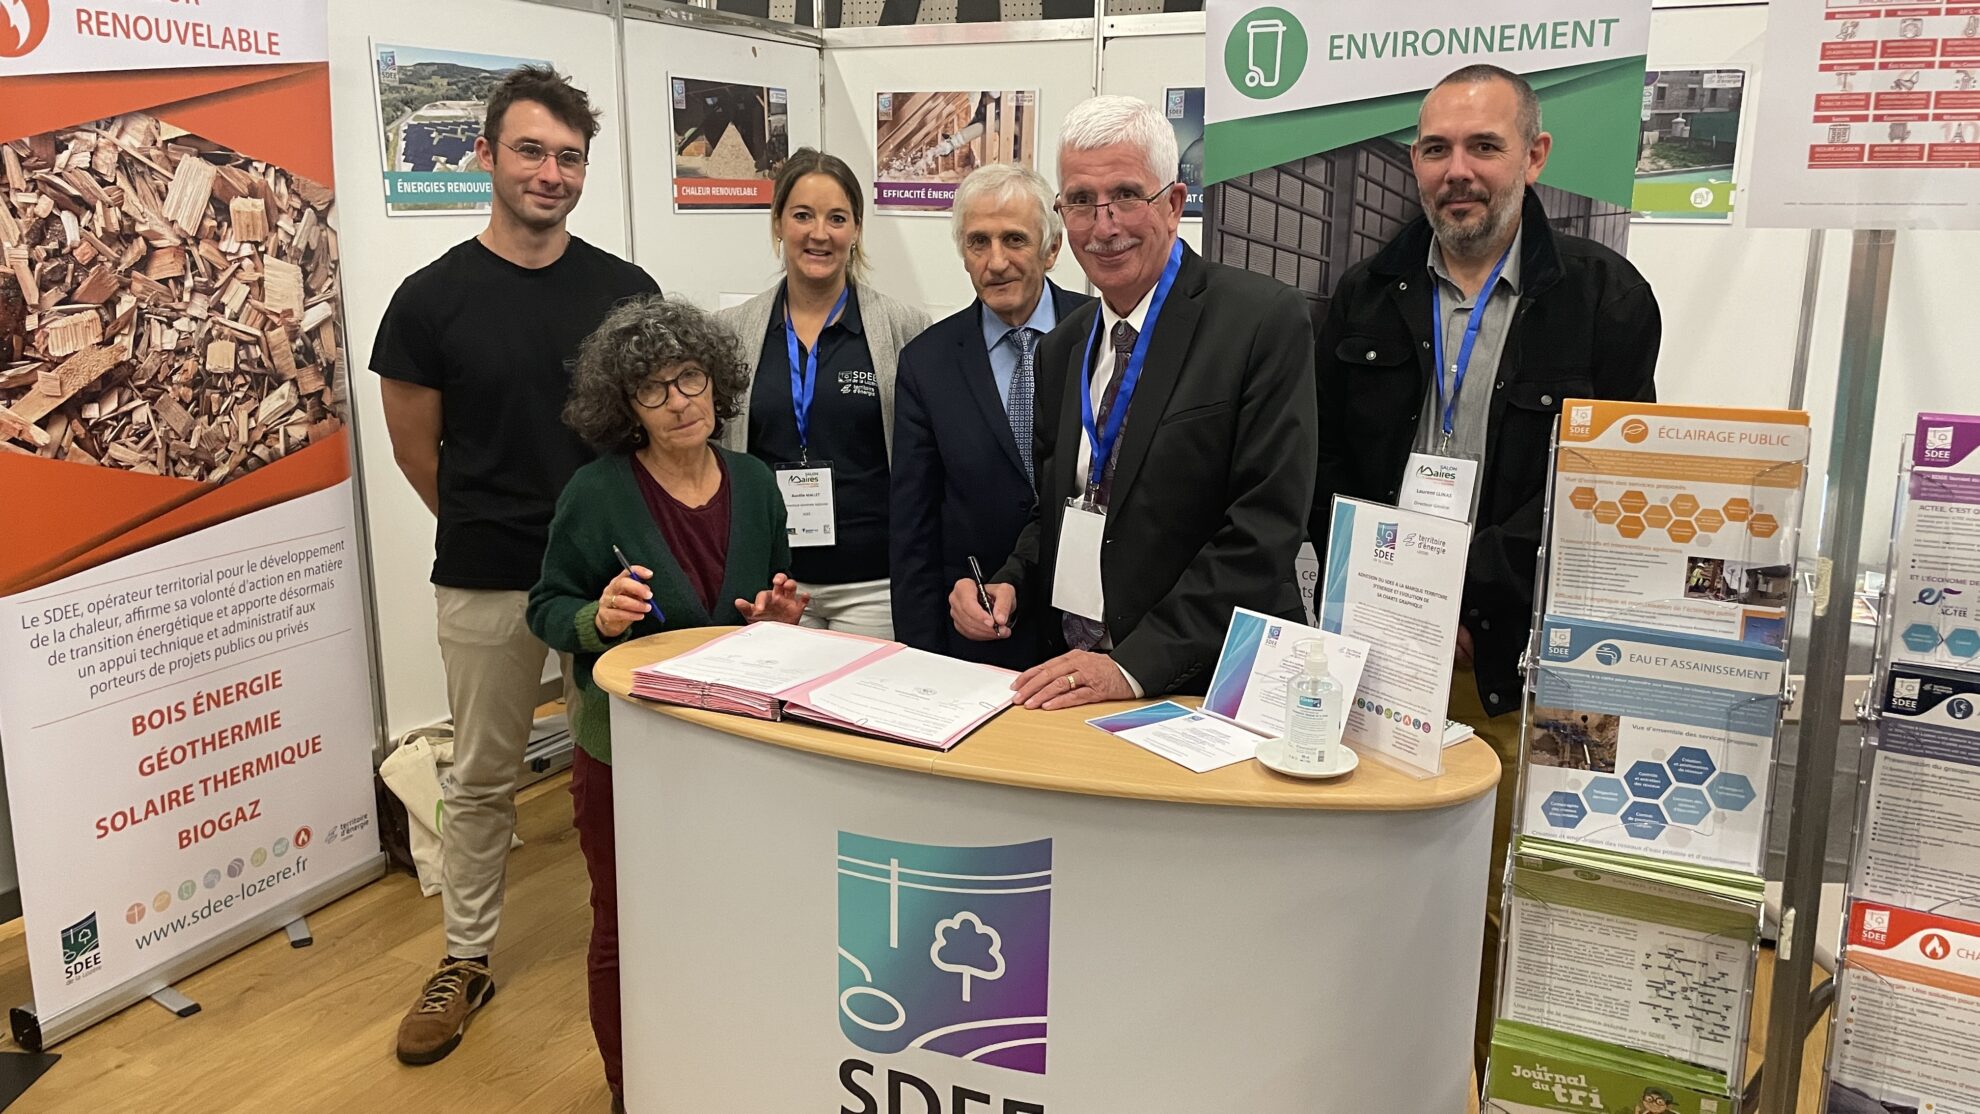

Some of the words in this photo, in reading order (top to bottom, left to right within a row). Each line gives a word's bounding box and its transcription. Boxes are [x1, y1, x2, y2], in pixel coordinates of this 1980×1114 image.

[76, 8, 281, 56] RENOUVELABLE
[1328, 18, 1620, 61] ENVIRONNEMENT
[397, 179, 446, 193] ÉNERGIES
[447, 181, 493, 193] RENOUVE
[681, 186, 711, 196] CHALEUR
[711, 186, 758, 196] RENOUVELABLE
[882, 188, 926, 199] EFFICACITÉ
[1569, 426, 1591, 434] SDEE
[1658, 426, 1736, 444] ÉCLAIRAGE
[1739, 432, 1792, 447] PUBLIC
[1924, 450, 1951, 459] SDEE
[1416, 488, 1435, 496] Laurent
[1417, 540, 1446, 555] d'énergie
[1418, 534, 1446, 547] territoire
[1373, 548, 1394, 562] SDEE
[21, 614, 40, 630] Le
[43, 602, 84, 625] SDEE,
[87, 587, 153, 616] opérateur
[155, 569, 213, 597] territorial
[216, 564, 245, 584] pour
[246, 559, 258, 574] le
[260, 540, 345, 570] développement
[30, 633, 50, 650] de
[53, 629, 66, 644] la
[69, 615, 122, 640] chaleur,
[125, 603, 171, 625] affirme
[174, 600, 188, 612] sa
[190, 581, 236, 608] volonté
[238, 573, 285, 595] d'action
[287, 569, 301, 582] en
[304, 558, 344, 578] matière
[48, 651, 66, 667] de
[70, 632, 134, 661] transition
[137, 609, 214, 642] énergétique
[216, 605, 229, 619] et
[231, 592, 277, 618] apporte
[279, 577, 335, 602] désormais
[78, 664, 96, 679] un
[99, 650, 137, 675] appui
[140, 631, 204, 661] technique
[206, 627, 219, 640] et
[221, 604, 293, 637] administratif
[295, 601, 316, 616] aux
[1548, 646, 1569, 656] SDEE
[89, 669, 146, 700] porteurs
[149, 661, 166, 678] de
[169, 650, 211, 676] projets
[214, 634, 256, 661] publics
[258, 630, 273, 644] ou
[276, 620, 309, 643] privés
[1629, 653, 1651, 665] EAU
[1655, 656, 1667, 667] ET
[1671, 658, 1770, 681] ASSAINISSEMENT
[132, 701, 187, 737] BOIS
[193, 669, 283, 717] ÉNERGIE
[1891, 697, 1917, 709] SDEE
[1632, 723, 1645, 732] Vue
[1646, 725, 1684, 736] d'ensemble
[138, 710, 282, 777] GÉOTHERMIE
[95, 784, 196, 839] SOLAIRE
[199, 734, 323, 797] THERMIQUE
[177, 798, 262, 850] BIOGAZ
[134, 855, 309, 950] www.sdee-lozere.fr
[1862, 930, 1887, 942] SDEE
[65, 951, 102, 980] SDEE
[1511, 1064, 1589, 1088] Journal
[1535, 1063, 1548, 1073] Le
[839, 1058, 1044, 1114] SD
[1532, 1080, 1550, 1092] du
[1551, 1085, 1604, 1110] tri
